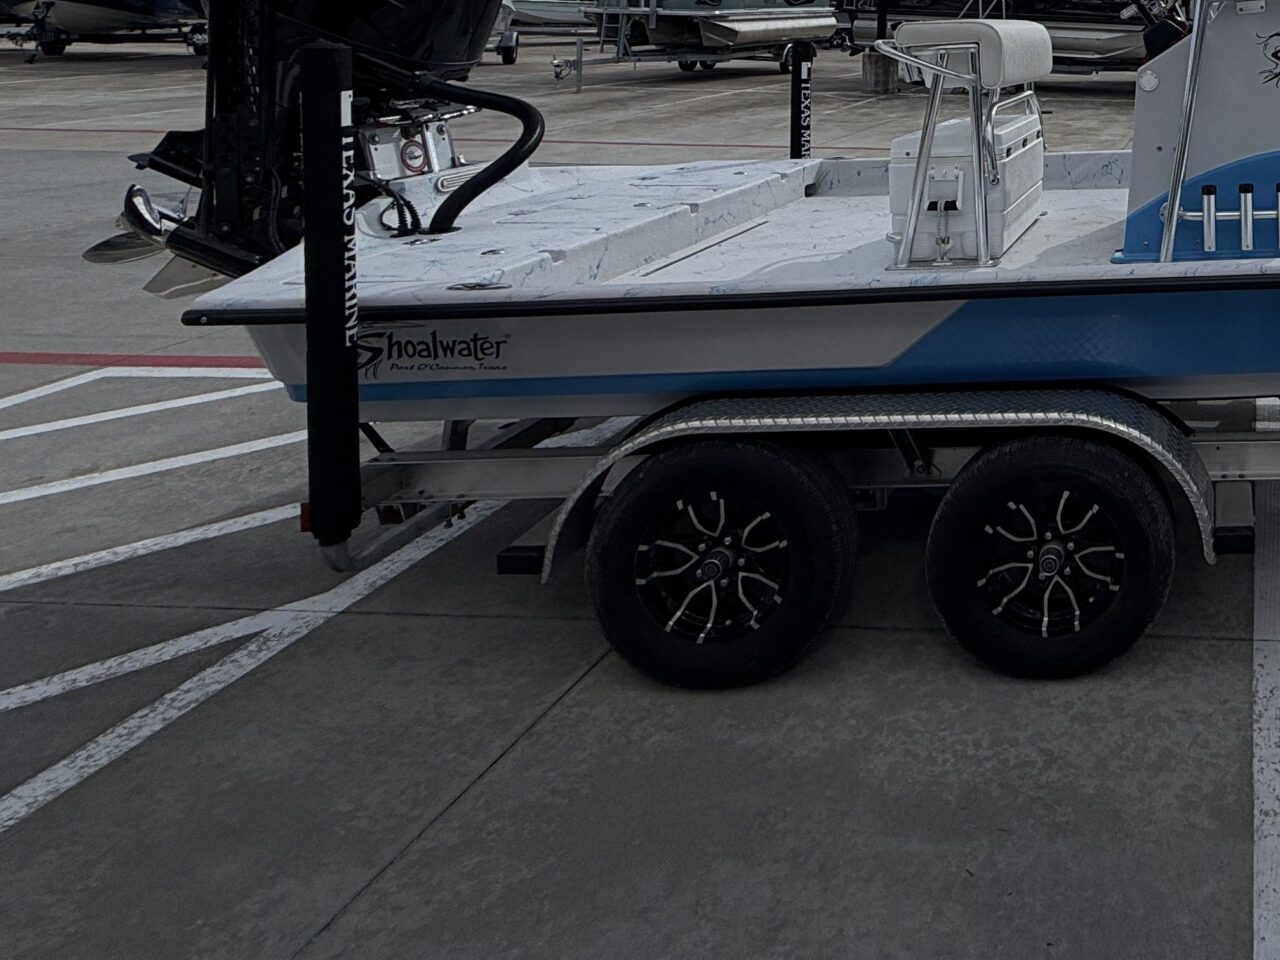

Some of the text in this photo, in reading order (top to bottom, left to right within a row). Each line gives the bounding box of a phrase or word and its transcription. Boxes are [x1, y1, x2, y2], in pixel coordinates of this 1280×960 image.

[801, 81, 811, 127] TEXAS
[344, 234, 359, 348] MARINE
[357, 329, 508, 370] Shoalwater
